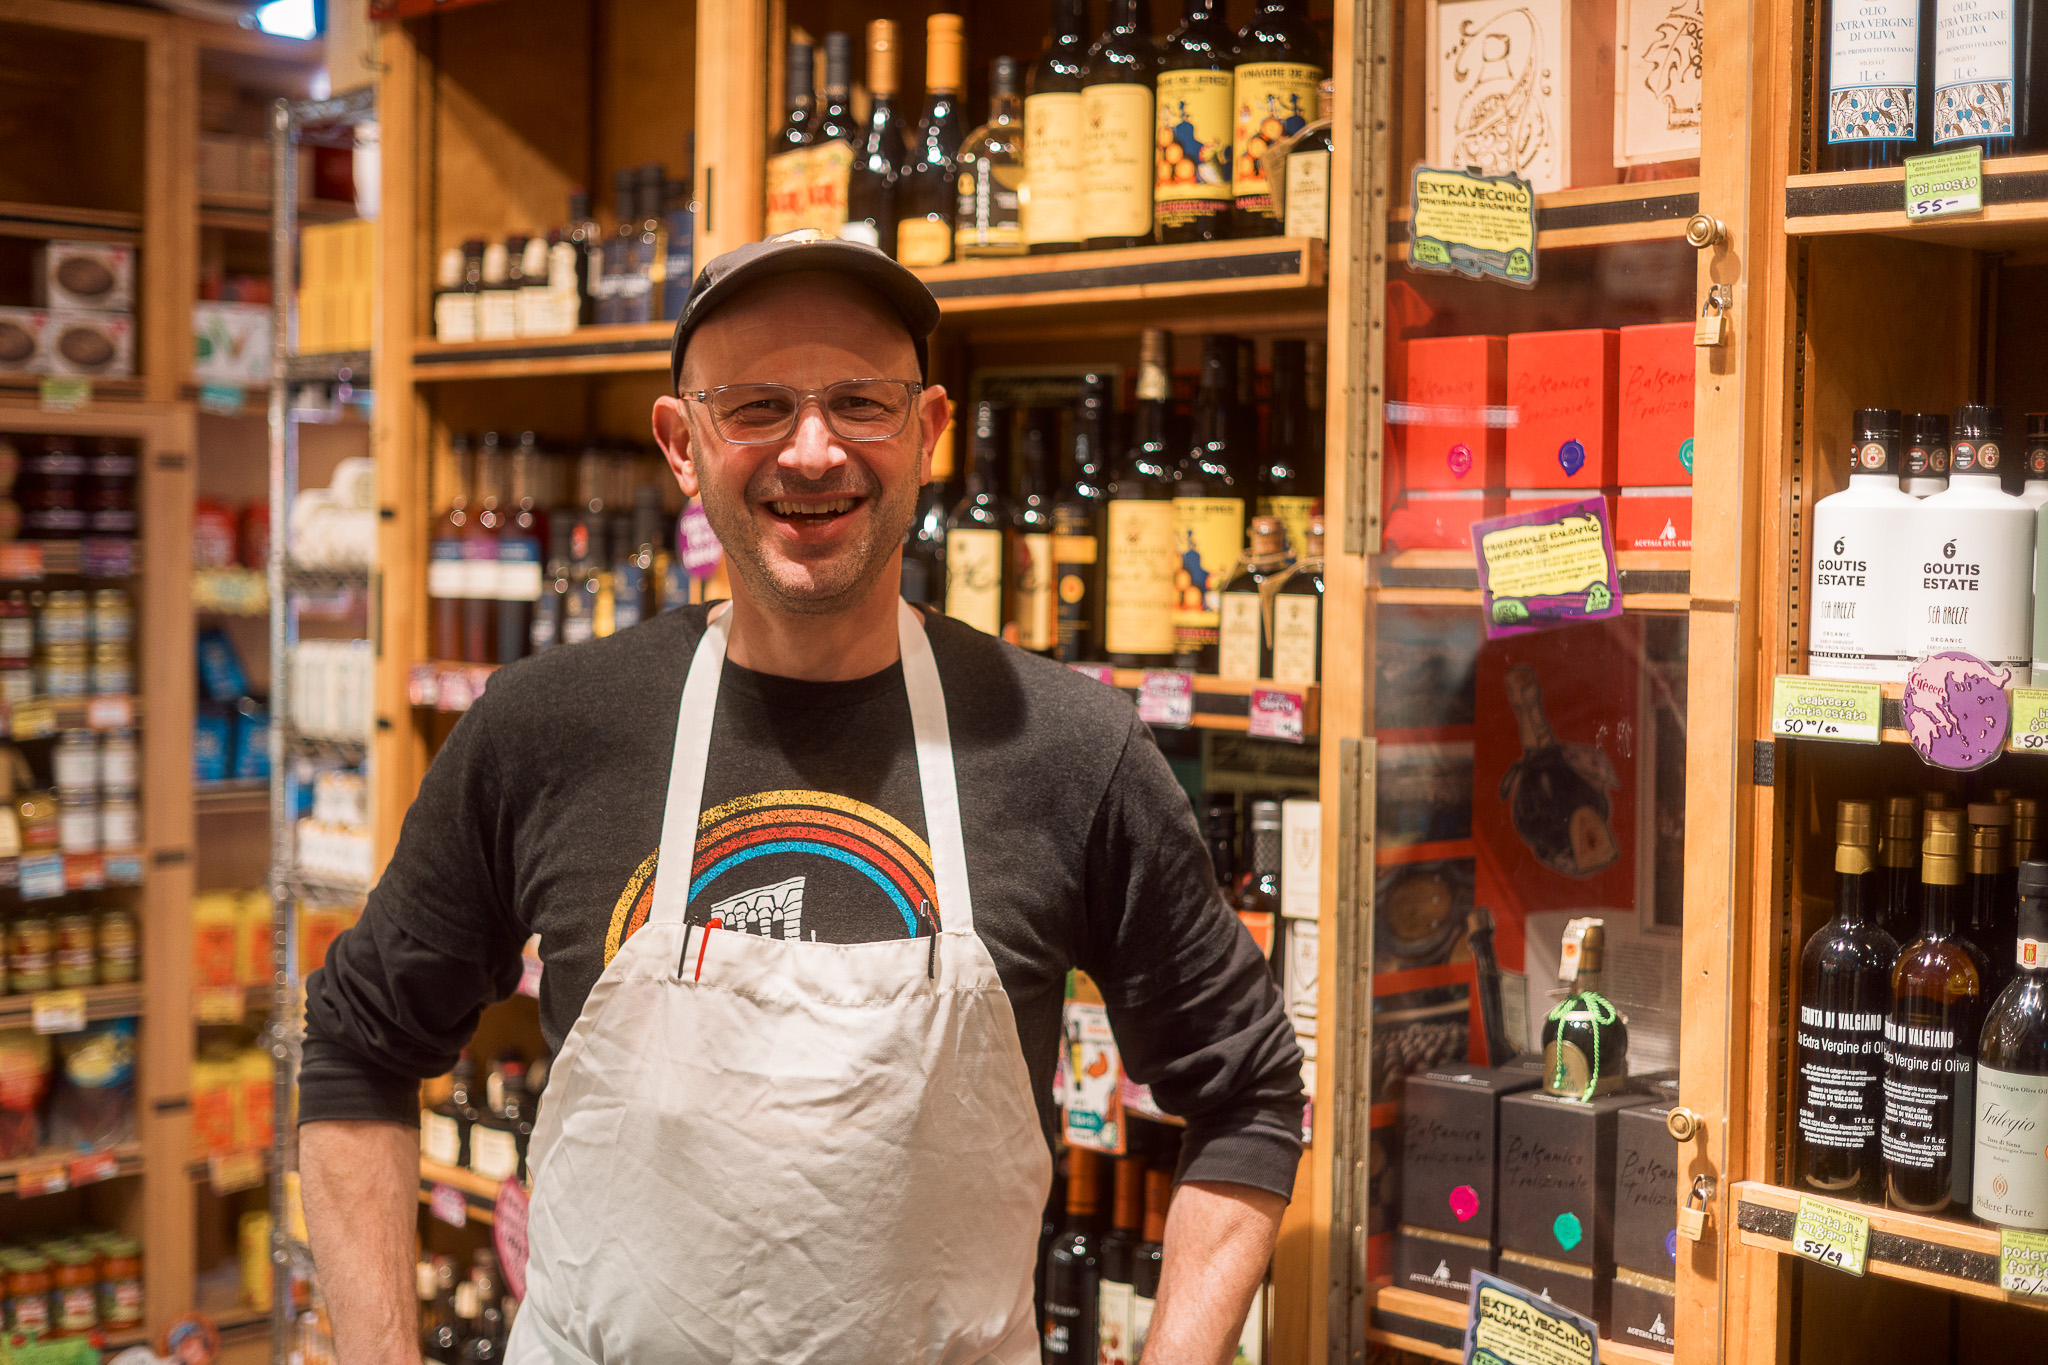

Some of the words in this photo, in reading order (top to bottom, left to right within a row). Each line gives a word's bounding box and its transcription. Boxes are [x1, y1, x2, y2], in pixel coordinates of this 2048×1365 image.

[1860, 6, 1886, 16] OLIO
[1952, 1, 1976, 13] OLIO
[1836, 20, 1865, 32] EXTRA
[1867, 18, 1914, 28] VERGINE
[1938, 18, 1958, 30] EXTRA
[1960, 10, 2007, 24] VERGINE
[1850, 32, 1860, 42] DI
[1864, 30, 1896, 40] OLIVA
[1946, 30, 1954, 40] DI
[1956, 25, 1987, 38] OLIVA
[1946, 43, 1973, 52] PRODOTTO
[1974, 40, 2007, 48] ITALIANO
[1953, 55, 1976, 63] MOSTO
[1420, 182, 1466, 198] EXTRA
[1467, 187, 1527, 203] VECCHIO
[1910, 183, 1929, 197] roi
[1932, 177, 1977, 192] mosto
[1514, 372, 1590, 402] Balsamico
[1626, 366, 1695, 402] Balsami
[1550, 524, 1599, 540] BALSAMIC
[1663, 539, 1677, 547] DEL
[1818, 560, 1867, 572] GOUTIS
[1924, 562, 1980, 576] GOUTIS
[1818, 574, 1865, 586] ESTATE
[1924, 578, 1979, 591] ESTATE
[1821, 600, 1831, 619] SEA
[1833, 602, 1856, 619] BREEZE
[1928, 605, 1940, 624] SEA
[1942, 606, 1970, 624] BREEZE
[1911, 672, 1944, 696] Greece
[1798, 695, 1855, 708] seabreeze
[1786, 704, 1822, 718] goutis
[1825, 707, 1866, 720] estate
[2016, 736, 2021, 744] $
[1802, 1006, 1822, 1027] TENUTA
[1825, 1011, 1835, 1029] DI
[1838, 1012, 1882, 1031] VALGIANO
[1803, 1033, 1820, 1050] Extra
[1822, 1038, 1859, 1055] Vergine
[1862, 1041, 1871, 1054] di
[1898, 1026, 1906, 1044] DI
[1908, 1028, 1954, 1048] VALGIANO
[1895, 1053, 1928, 1070] Vergine
[1932, 1059, 1941, 1072] di
[1945, 1060, 1970, 1072] Oliva
[1808, 1091, 1826, 1100] TENUTA
[1901, 1118, 1916, 1126] Product
[1905, 1112, 1932, 1121] VALGIANO
[1505, 1134, 1584, 1168] Balsamico
[1909, 1142, 1931, 1150] Novembre
[1976, 1196, 2002, 1213] Podere
[2005, 1204, 2034, 1218] Forte
[1800, 1208, 1840, 1231] tenuta
[1842, 1222, 1853, 1233] di
[1827, 1208, 1842, 1216] green
[1849, 1214, 1863, 1224] nutty
[1482, 1308, 1531, 1336] BALSAMIC
[1482, 1296, 1530, 1324] EXTRA
[1532, 1314, 1591, 1352] VECCHIO
[1627, 1327, 1652, 1339] ACETAIA
[1653, 1334, 1665, 1344] DEL
